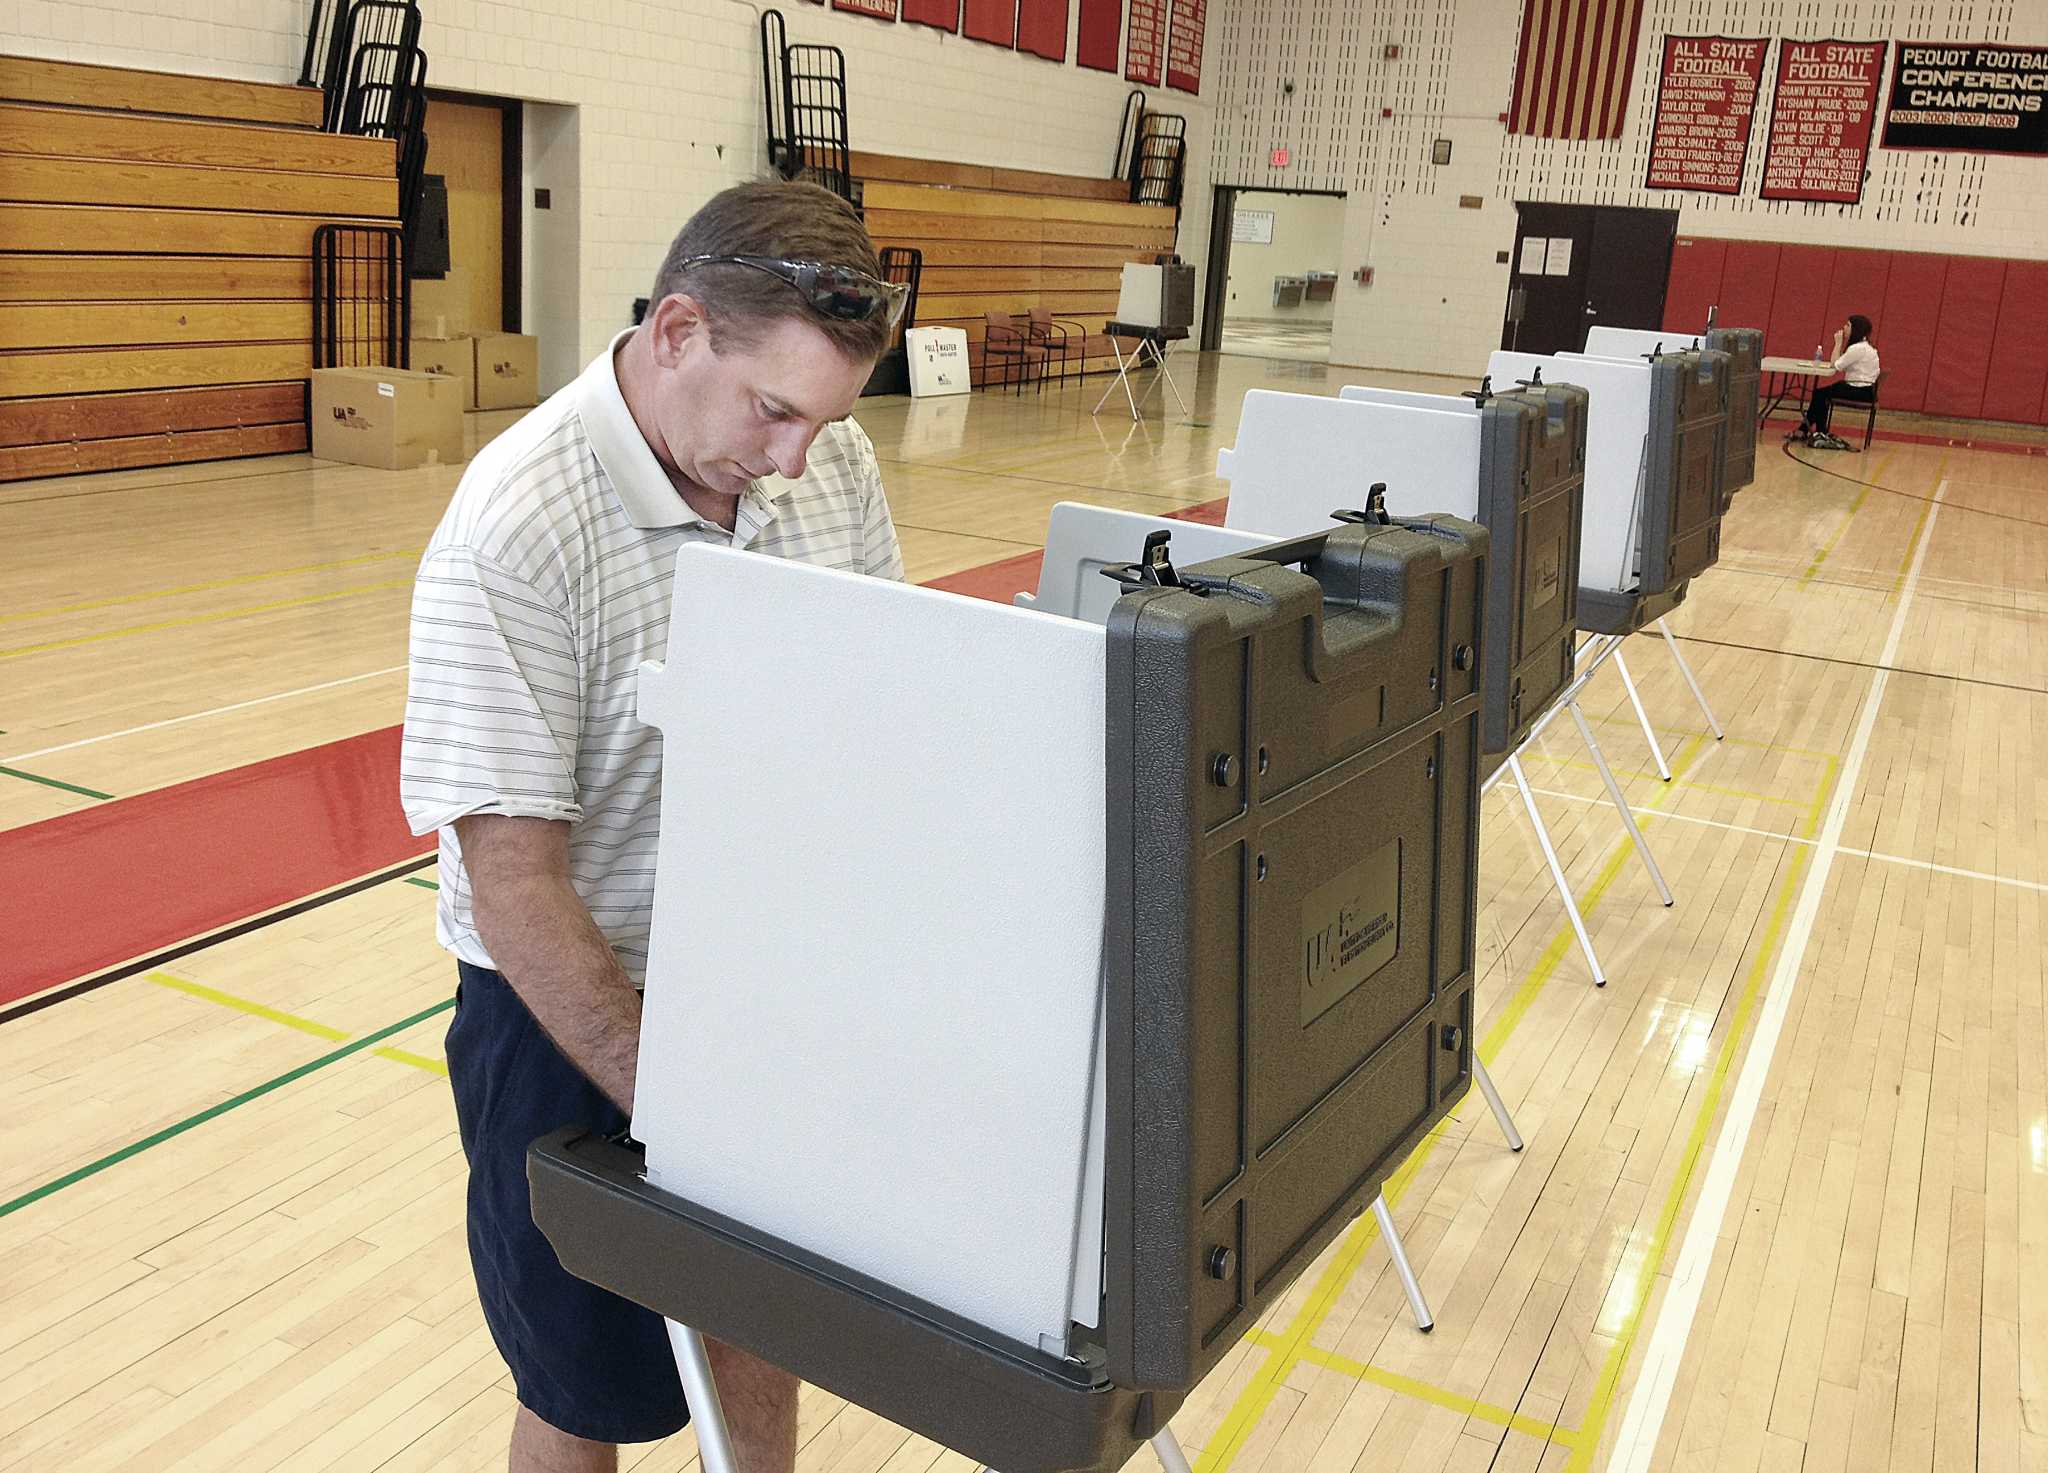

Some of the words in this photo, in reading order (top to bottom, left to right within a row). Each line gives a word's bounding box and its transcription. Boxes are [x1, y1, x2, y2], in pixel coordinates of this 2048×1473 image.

[1674, 42, 1703, 57] ALL
[1709, 43, 1757, 59] STATE
[1790, 46, 1820, 62] ALL
[1826, 46, 1875, 64] STATE
[1903, 49, 1970, 66] PEQUOT
[1673, 59, 1749, 76] FOOTBALL
[1788, 63, 1869, 80] FOOTBALL
[1664, 77, 1688, 88] TYLER
[1661, 89, 1683, 100] DAVID
[1779, 85, 1805, 97] SHAWN
[1661, 101, 1688, 112] TAYLOR
[1778, 98, 1815, 109] TYSHAWN
[1910, 89, 2043, 112] CHAMPIONS
[1775, 110, 1797, 121] MATT
[1773, 122, 1797, 133] KEVIN
[1772, 134, 1797, 145] JAMIE
[1799, 135, 1824, 146] SCOTT
[1653, 148, 1687, 159] ALFREDO
[1771, 145, 1811, 157] LAURENZO
[1652, 160, 1680, 170] AUSTIN
[1769, 157, 1803, 168] MICHAEL
[1650, 171, 1681, 183] MICHAEL
[1766, 167, 1803, 178] ANTHONY
[1766, 178, 1798, 190] MICHAEL
